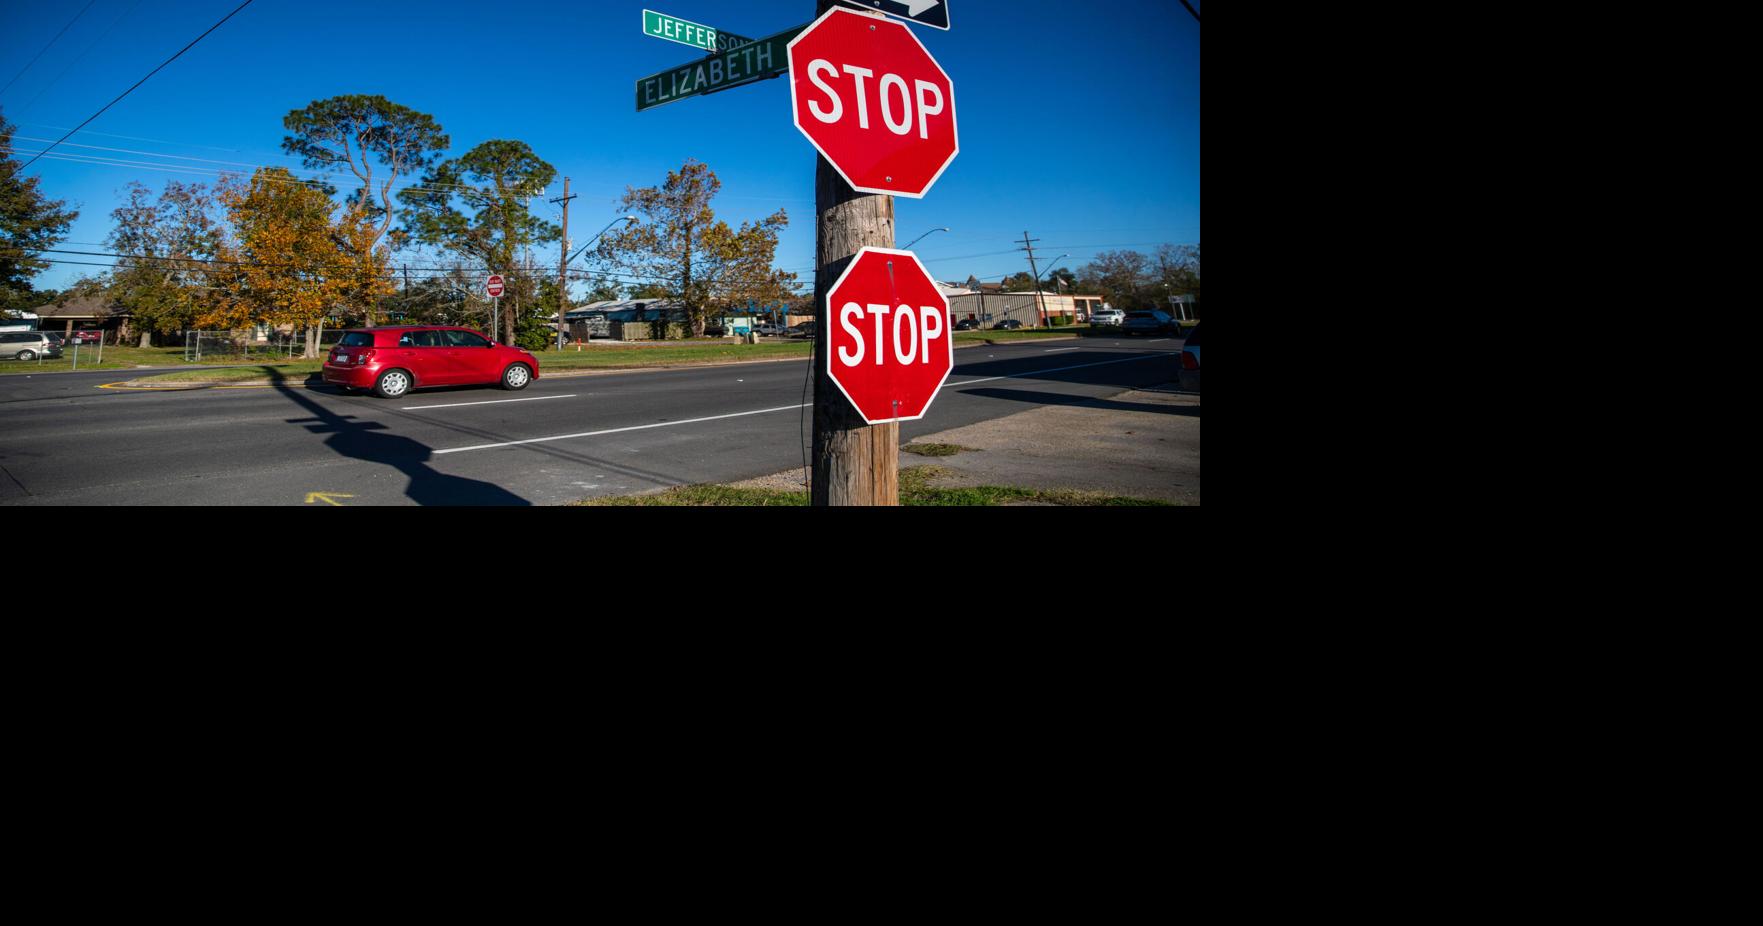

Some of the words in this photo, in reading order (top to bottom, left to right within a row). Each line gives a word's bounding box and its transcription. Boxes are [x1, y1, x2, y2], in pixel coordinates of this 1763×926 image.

[645, 42, 773, 104] ELIZABETH
[807, 59, 944, 140] STOP
[838, 302, 943, 367] STOP
